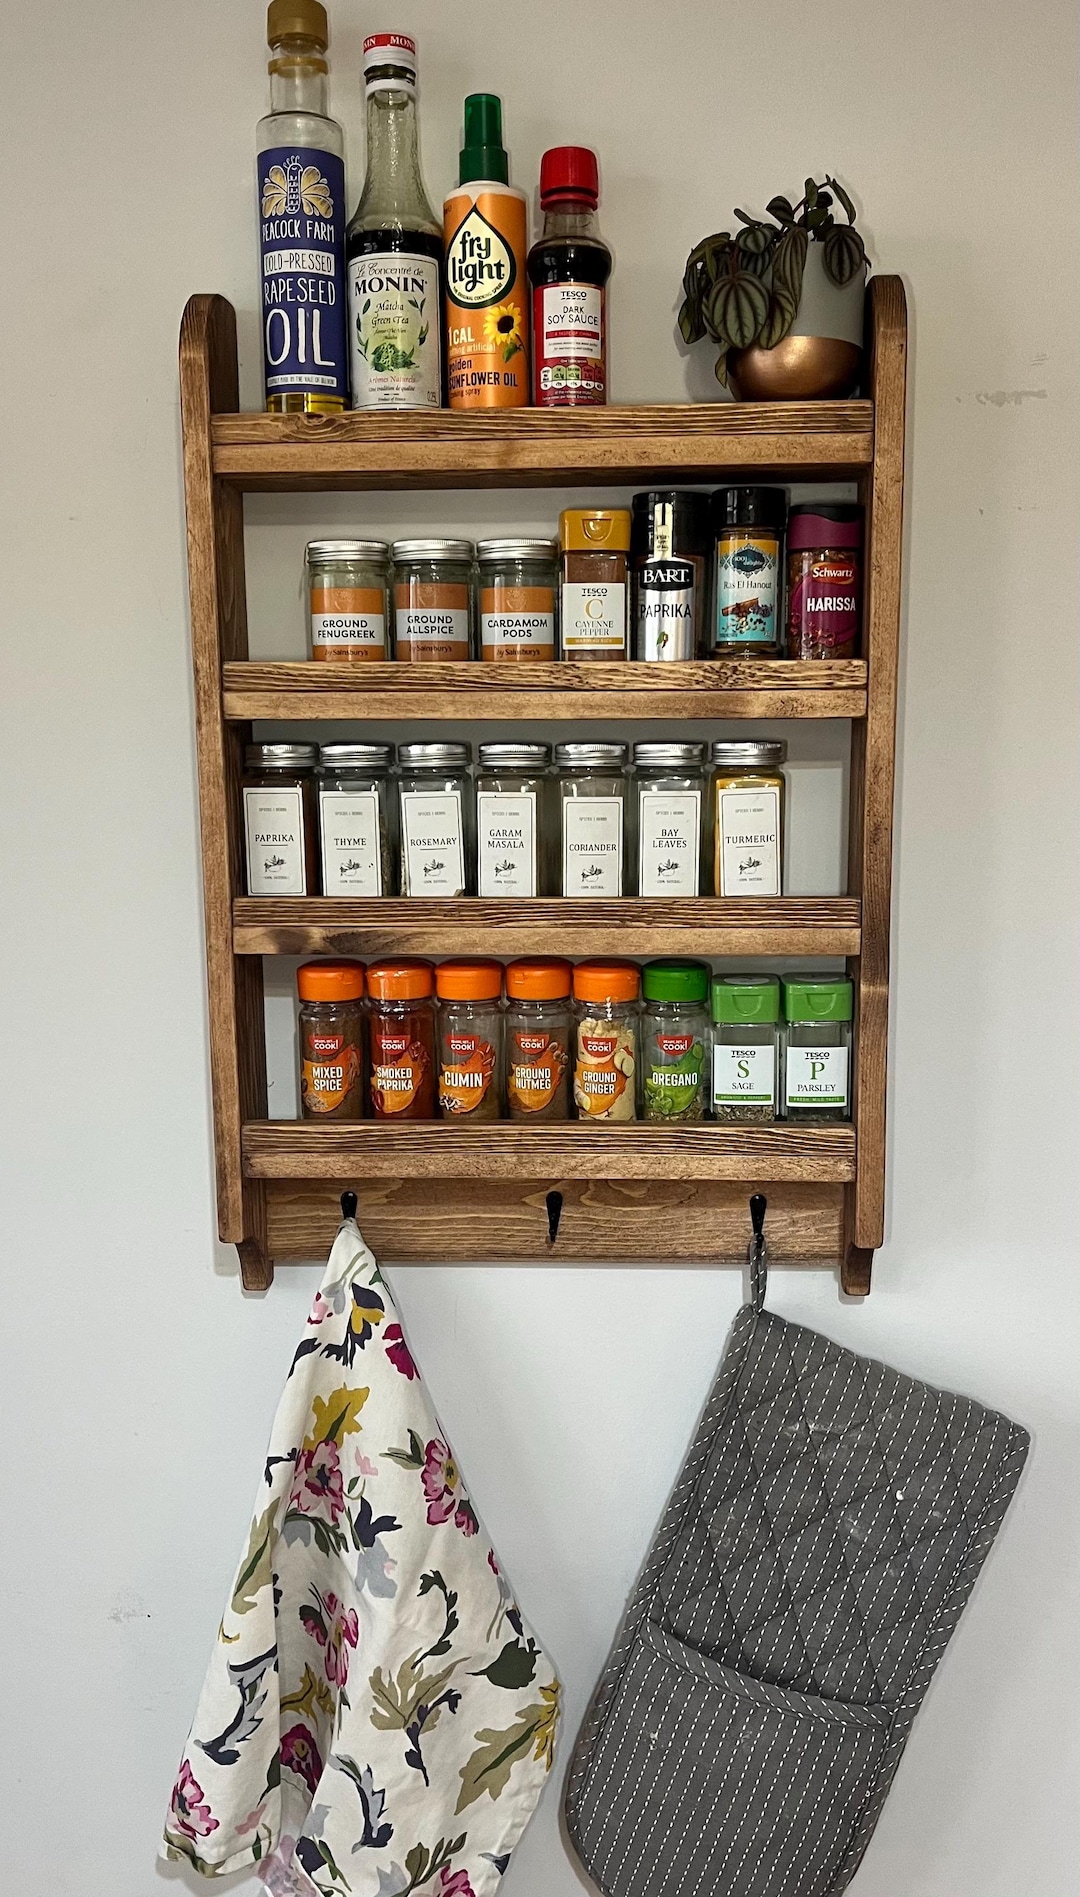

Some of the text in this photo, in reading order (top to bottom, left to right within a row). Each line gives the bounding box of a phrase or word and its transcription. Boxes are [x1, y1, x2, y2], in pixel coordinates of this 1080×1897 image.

[263, 219, 335, 243] PEACOCK FARM
[459, 231, 490, 264] fry
[265, 253, 332, 274] COLD-PRESSED
[355, 264, 366, 279] Le
[414, 266, 424, 276] de
[452, 257, 505, 293] light
[264, 278, 336, 306] RAPESEED
[355, 277, 425, 296] MONIN
[560, 290, 587, 299] TESCO
[375, 300, 404, 313] Matcha
[563, 306, 584, 314] DARK
[371, 314, 409, 328] Green Tea
[547, 315, 598, 326] SOY SAUCE
[266, 308, 336, 366] OIL
[449, 372, 500, 390] SUNFLOWER
[503, 372, 518, 387] OIL
[465, 388, 480, 396] spray
[643, 568, 688, 584] BART
[812, 567, 853, 578] Schwartz
[724, 580, 772, 589] Ras El Hanout
[581, 588, 608, 596] TESCO
[585, 598, 604, 619] C
[807, 597, 856, 612] HARISSA
[640, 603, 692, 619] PAPRIKA
[322, 619, 368, 628] GROUND
[407, 615, 453, 624] GROUND
[487, 619, 548, 628] CARDAMOM
[575, 620, 614, 628] CAYENNE
[317, 629, 376, 638] FENUGREEK
[406, 625, 454, 634] ALLSPICE
[503, 629, 532, 638] PODS
[332, 649, 368, 657] Sainsbury's
[255, 834, 294, 842] PAPRIKA
[489, 829, 522, 837] GARAM
[661, 829, 679, 837] BAY
[334, 838, 367, 846] THYME
[410, 837, 457, 846] ROSEMARY
[487, 840, 525, 849] MASALA
[652, 840, 687, 848] LEAVES
[725, 834, 775, 844] TURMERIC
[569, 843, 617, 852] CORIANDER
[731, 1050, 756, 1058] TESCO
[312, 1066, 343, 1078] MIXED
[377, 1067, 413, 1079] SMOKED
[515, 1067, 551, 1079] GROUND
[737, 1059, 750, 1078] S
[810, 1061, 825, 1080] P
[444, 1071, 483, 1087] CUMIN
[582, 1071, 617, 1083] GROUND
[652, 1072, 698, 1086] OREGANO
[314, 1079, 342, 1091] SPICE
[377, 1079, 413, 1091] PAPRIKA
[515, 1079, 551, 1089] NUTMEG
[584, 1082, 615, 1094] GINGER
[731, 1082, 755, 1090] SAGE
[797, 1084, 836, 1092] PARSLEY
